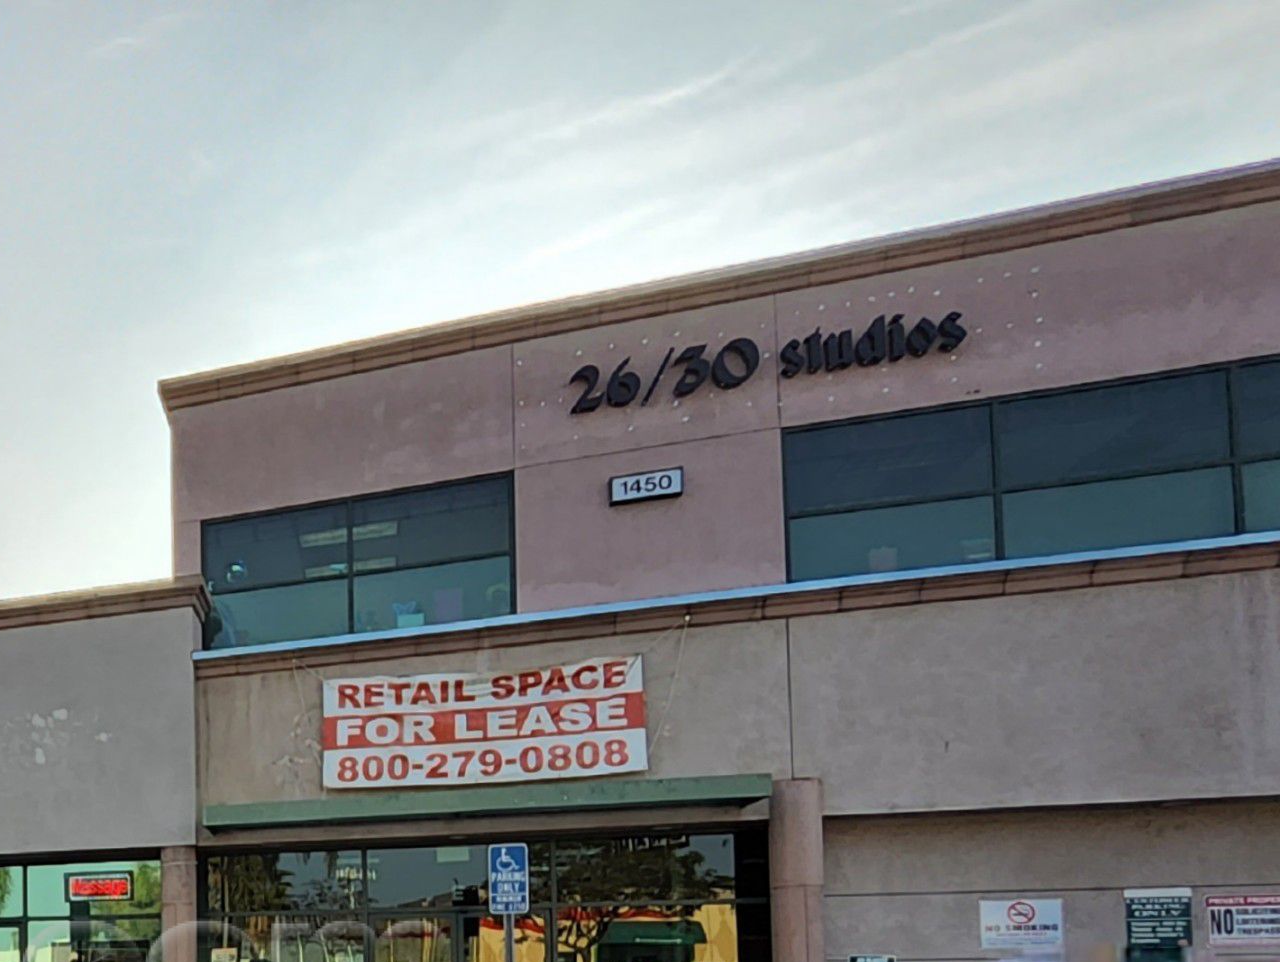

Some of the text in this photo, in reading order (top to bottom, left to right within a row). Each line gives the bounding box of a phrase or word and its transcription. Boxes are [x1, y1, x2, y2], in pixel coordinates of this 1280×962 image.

[569, 311, 968, 414] 26/30 studios
[620, 475, 674, 496] 1450
[338, 661, 628, 709] RETAIL SPACE
[336, 697, 628, 746] FOR LEASE
[337, 739, 630, 783] 800-279-0808
[72, 878, 128, 897] Massage
[1210, 909, 1234, 935] NO
